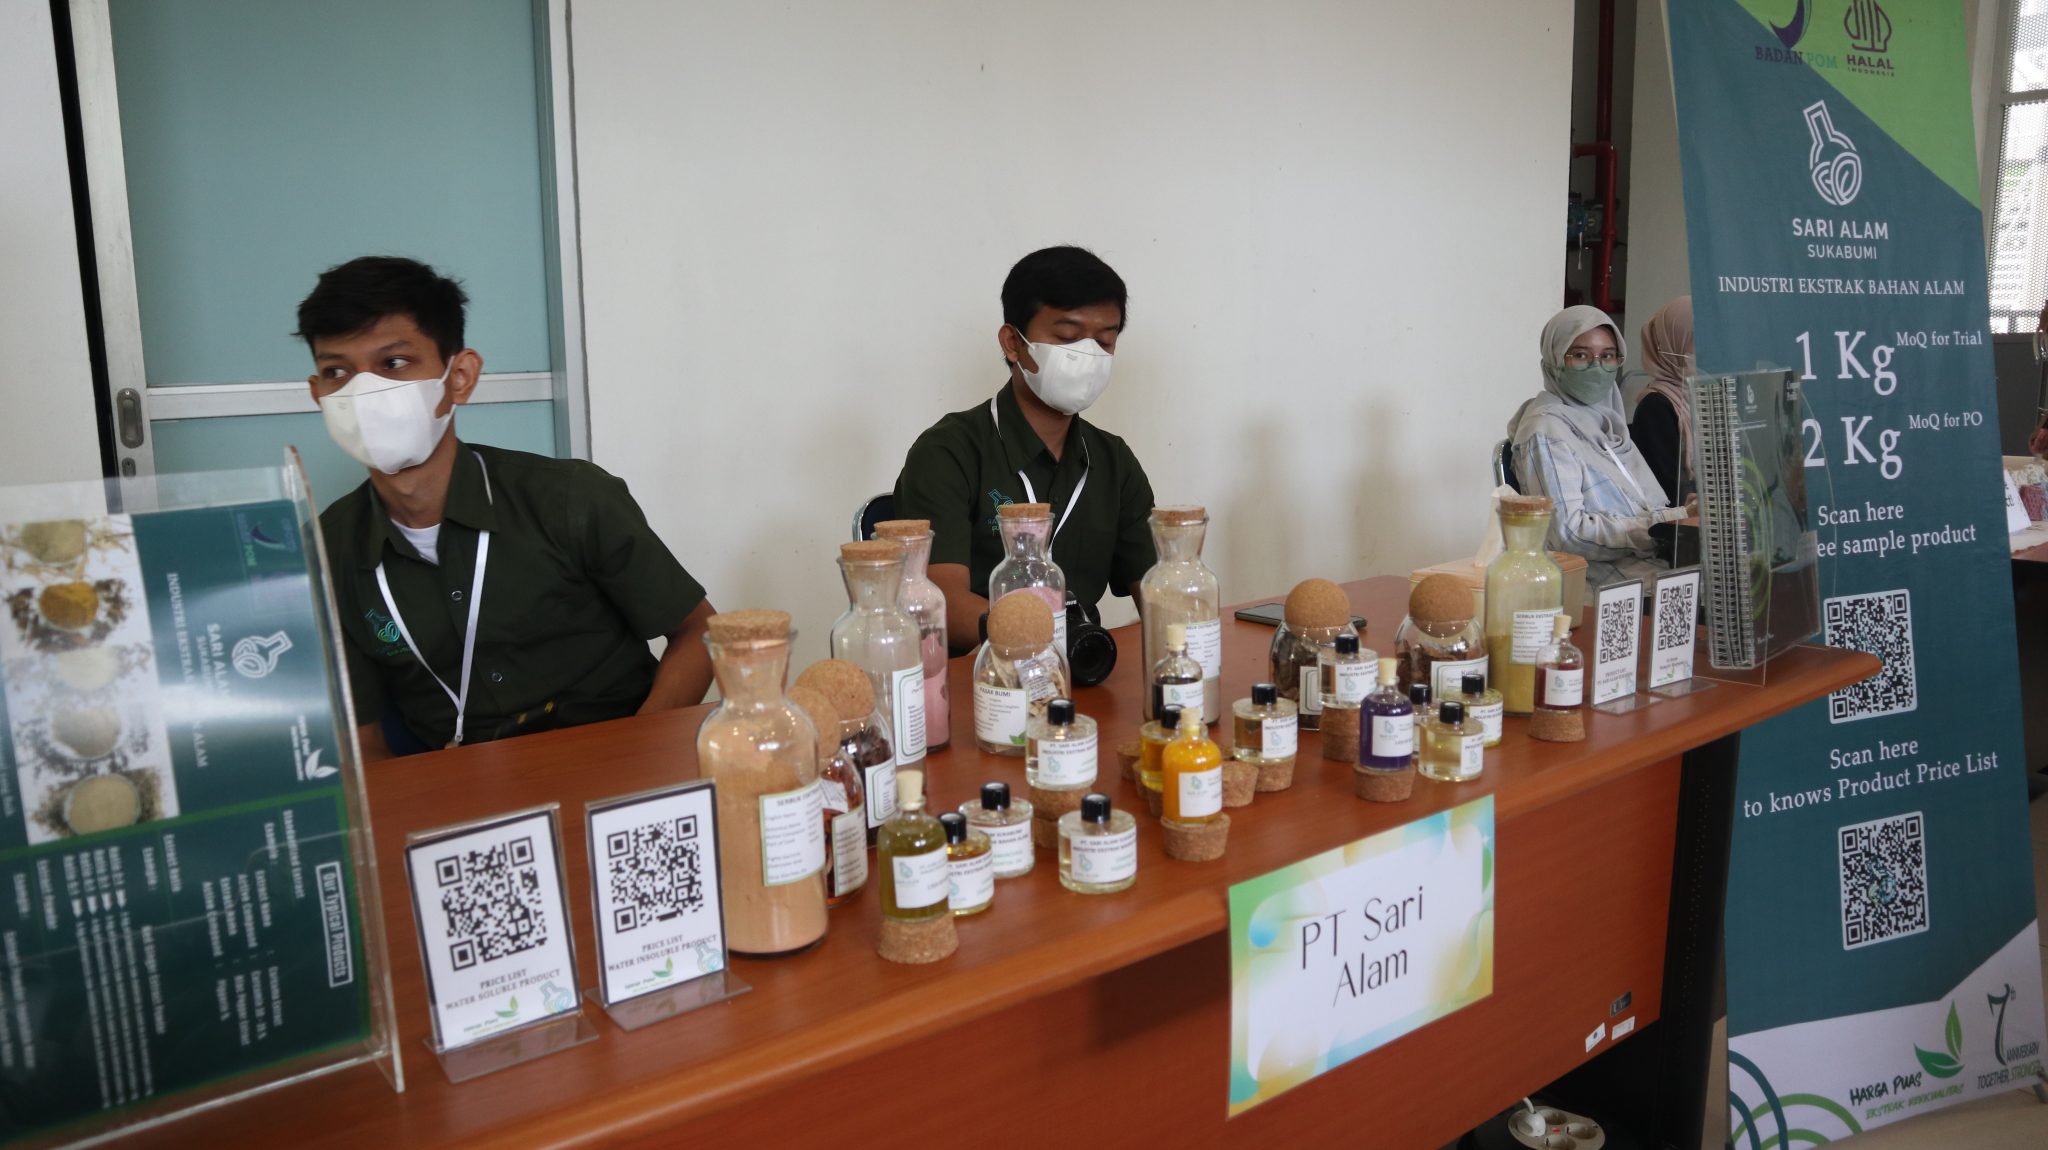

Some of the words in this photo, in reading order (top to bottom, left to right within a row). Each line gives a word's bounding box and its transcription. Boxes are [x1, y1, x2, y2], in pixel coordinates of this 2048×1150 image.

[1755, 46, 1803, 65] BADAN
[1806, 51, 1838, 69] POM
[1847, 54, 1894, 70] HALAL
[1847, 67, 1895, 77] INDONESIA
[1792, 218, 1834, 237] SARI
[1840, 221, 1889, 240] ALAM
[1807, 244, 1877, 260] SUKABUMI
[1719, 276, 1794, 293] INDUSTRI
[1800, 278, 1865, 294] EKSTRAK
[1868, 280, 1920, 295] BAHAN
[1924, 281, 1965, 296] ALAM
[1796, 331, 1817, 380] 1
[1834, 331, 1898, 396] Kg
[1896, 332, 1928, 349] MoQ
[1931, 331, 1950, 347] for
[1953, 331, 1983, 346] Trial
[1801, 418, 1826, 468] 2
[1841, 416, 1903, 480] Kg
[1909, 414, 1940, 430] MoQ
[1943, 413, 1961, 428] for
[1963, 411, 1983, 426] PO
[1818, 506, 1860, 526] Scan
[1865, 501, 1904, 521] here
[1843, 534, 1905, 557] sample
[1912, 524, 1977, 553] product
[166, 572, 186, 628] INDUSTRI
[206, 622, 223, 657] SARI
[1830, 748, 1873, 770] Scan
[1879, 739, 1919, 763] here
[1743, 798, 1763, 818] to
[1769, 787, 1832, 814] knows
[1838, 772, 1911, 799] Product
[1916, 760, 1961, 785] Price
[1965, 751, 1999, 772] List
[322, 872, 338, 892] Our
[322, 892, 344, 932] Typical
[1301, 908, 1347, 970] PT
[1363, 886, 1424, 942] Sari
[329, 932, 349, 977] Products
[607, 958, 634, 973] WATER
[635, 945, 680, 965] INSOLUBLE
[642, 940, 665, 954] PRICE
[666, 934, 684, 948] LIST
[445, 996, 476, 1011] WATER
[477, 983, 517, 1002] SOLUBLE
[518, 968, 561, 989] PRODUCT
[479, 974, 506, 990] PRICE
[507, 968, 527, 983] LIST
[1333, 948, 1408, 1008] Alam
[1849, 1080, 1890, 1107] HARGA
[1893, 1072, 1922, 1095] PUAS
